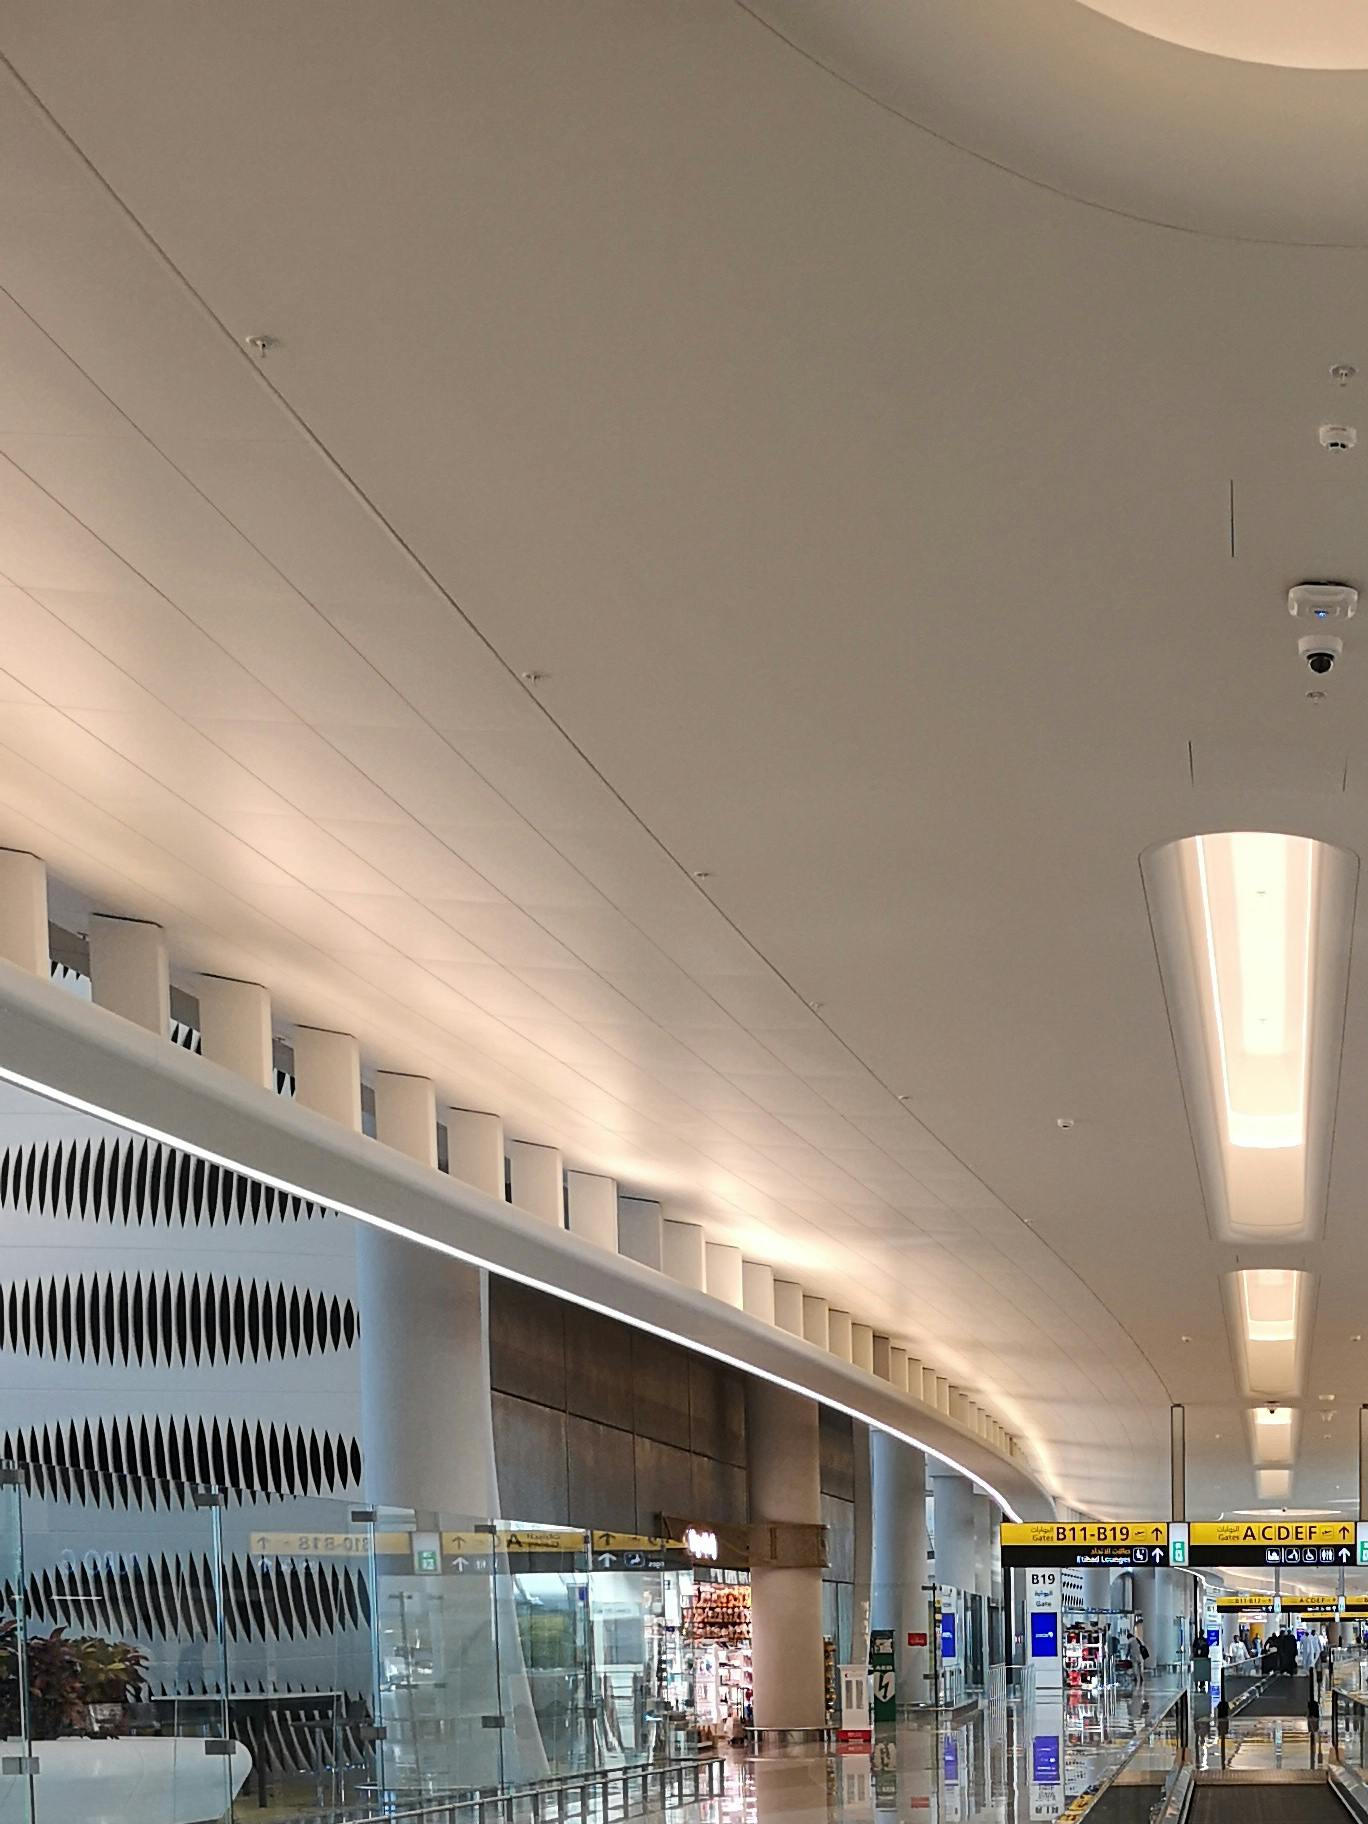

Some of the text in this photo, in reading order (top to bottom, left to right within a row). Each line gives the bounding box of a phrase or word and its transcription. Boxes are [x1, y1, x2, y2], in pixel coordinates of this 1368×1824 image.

[1056, 1526, 1130, 1541] B11-B19
[1031, 1573, 1055, 1585] B19
[1035, 1600, 1052, 1608] Gate
